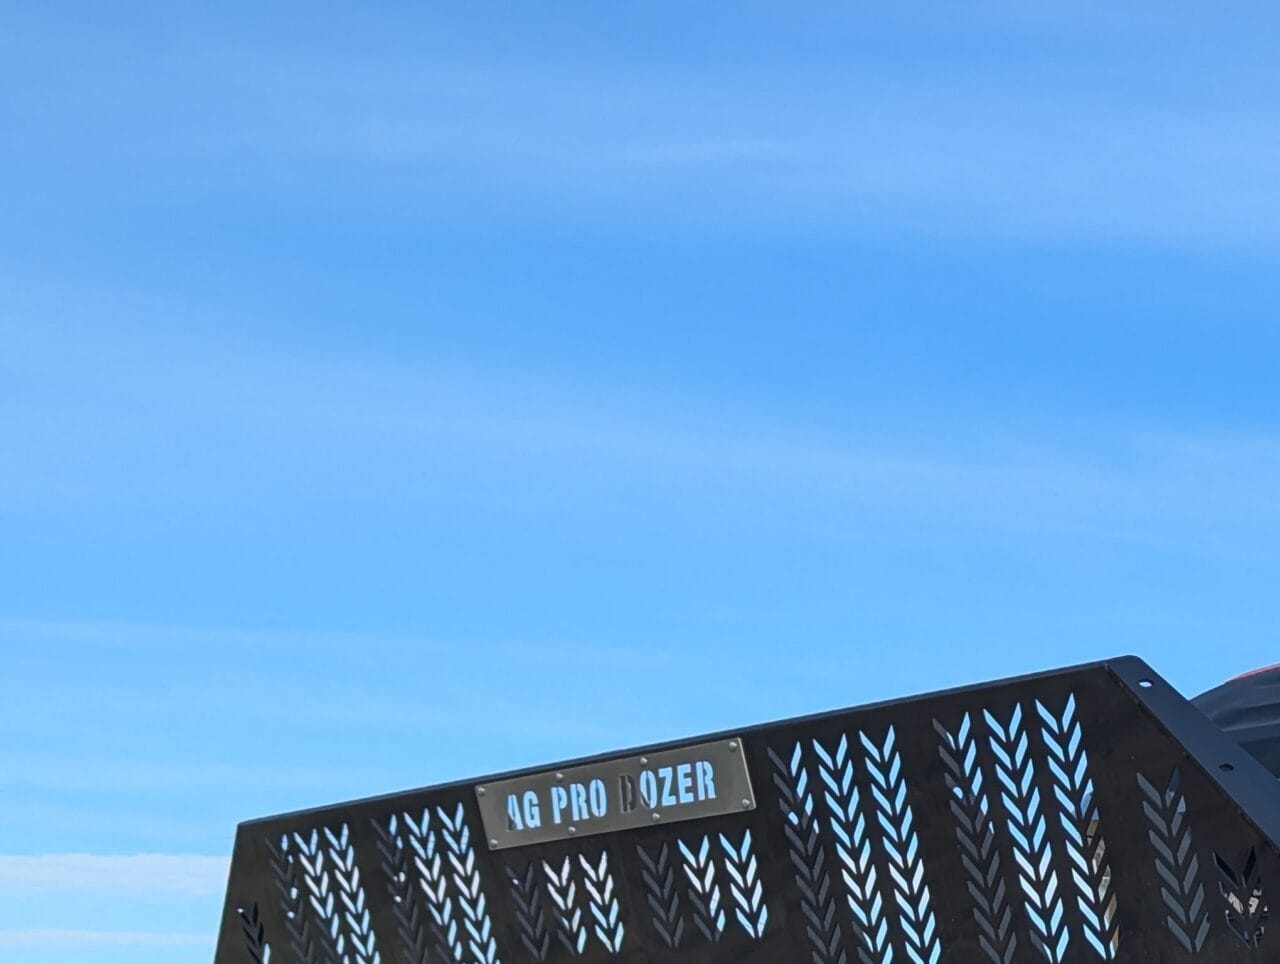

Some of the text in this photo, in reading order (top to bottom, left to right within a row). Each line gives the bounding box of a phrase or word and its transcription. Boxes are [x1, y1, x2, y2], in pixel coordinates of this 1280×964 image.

[507, 760, 716, 831] AG PRO DOZER
